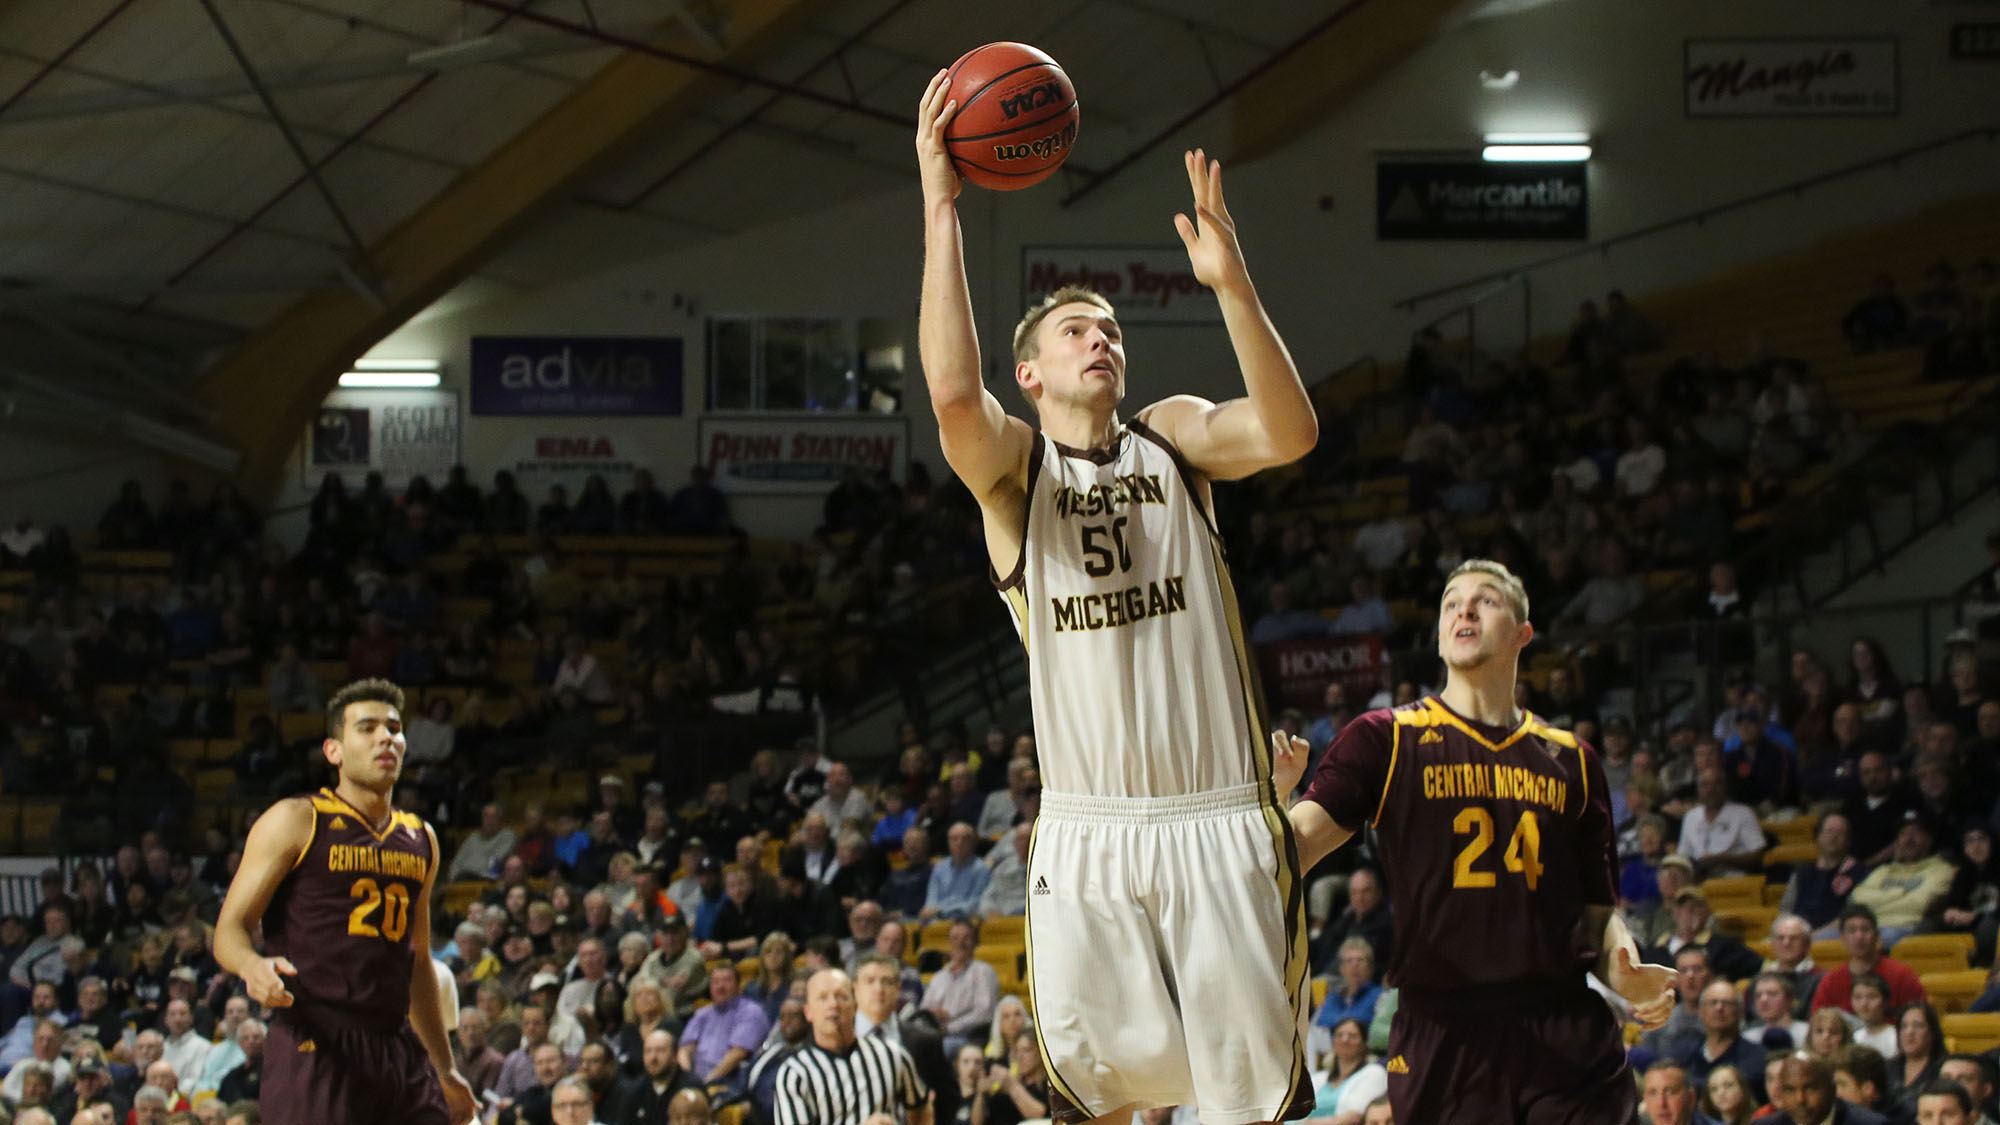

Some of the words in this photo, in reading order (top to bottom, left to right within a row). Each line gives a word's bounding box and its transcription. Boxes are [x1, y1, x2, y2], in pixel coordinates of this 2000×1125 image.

[1688, 49, 1855, 103] Mangia
[1000, 80, 1064, 120] NCAA
[995, 121, 1076, 160] Wilson
[1428, 178, 1582, 208] Mercantile
[1030, 261, 1122, 294] Metro
[1128, 262, 1215, 308] Toyo
[501, 345, 653, 389] advia
[383, 405, 453, 426] SCOTT
[536, 437, 614, 458] EMA
[1052, 576, 1187, 632] MICHIGAN
[1280, 644, 1371, 677] HONOR
[1423, 763, 1494, 799] CENTRAL
[1494, 764, 1566, 815] MICHIGAN
[328, 844, 380, 873] CENTRAL
[1453, 806, 1544, 891] 24
[347, 877, 410, 943] 20
